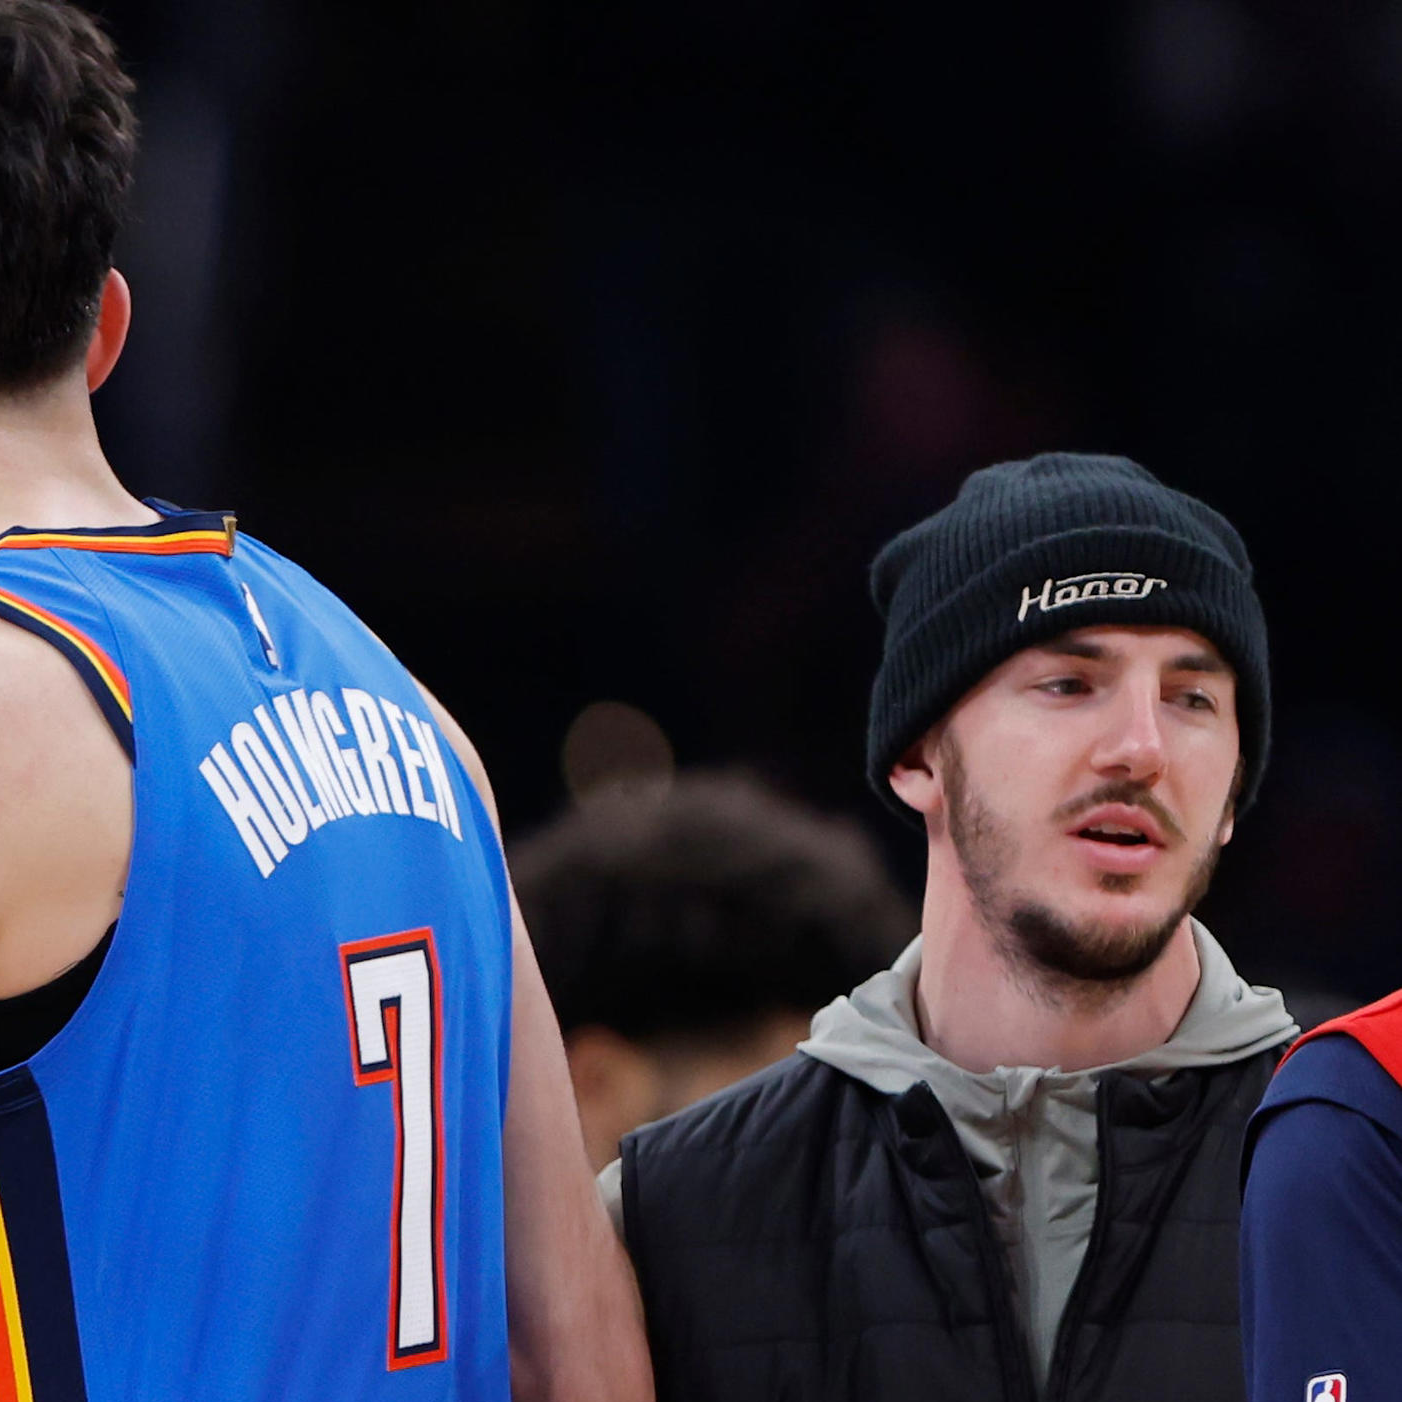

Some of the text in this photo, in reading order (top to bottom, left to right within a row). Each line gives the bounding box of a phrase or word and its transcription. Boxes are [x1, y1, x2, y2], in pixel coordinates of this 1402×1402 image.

[1016, 571, 1169, 624] Honor
[198, 687, 464, 880] HOLMGREN
[338, 926, 448, 1373] 7
